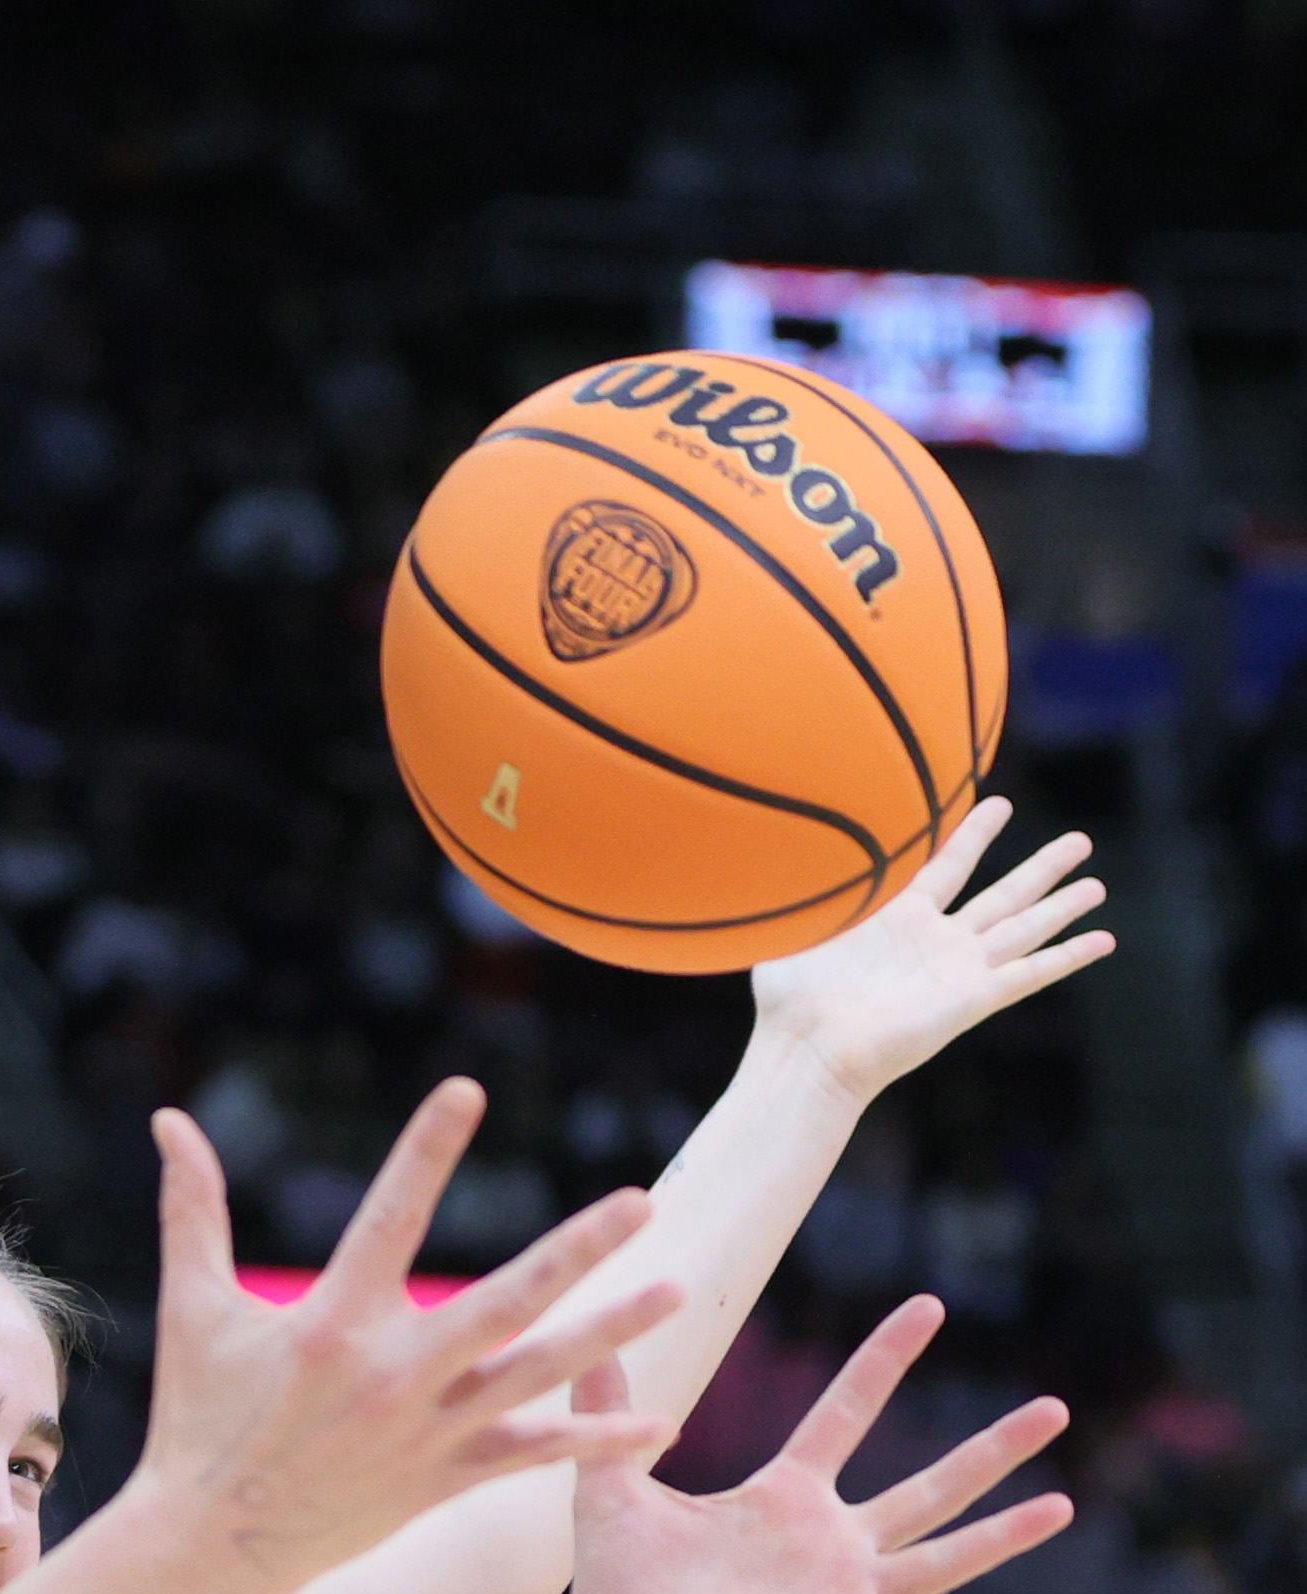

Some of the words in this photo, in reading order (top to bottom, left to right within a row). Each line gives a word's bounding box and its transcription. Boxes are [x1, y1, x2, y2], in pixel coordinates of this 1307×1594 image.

[652, 428, 708, 461] EVO
[572, 363, 902, 605] Wilson
[557, 556, 645, 630] FOUR
[581, 527, 664, 600] FINAL
